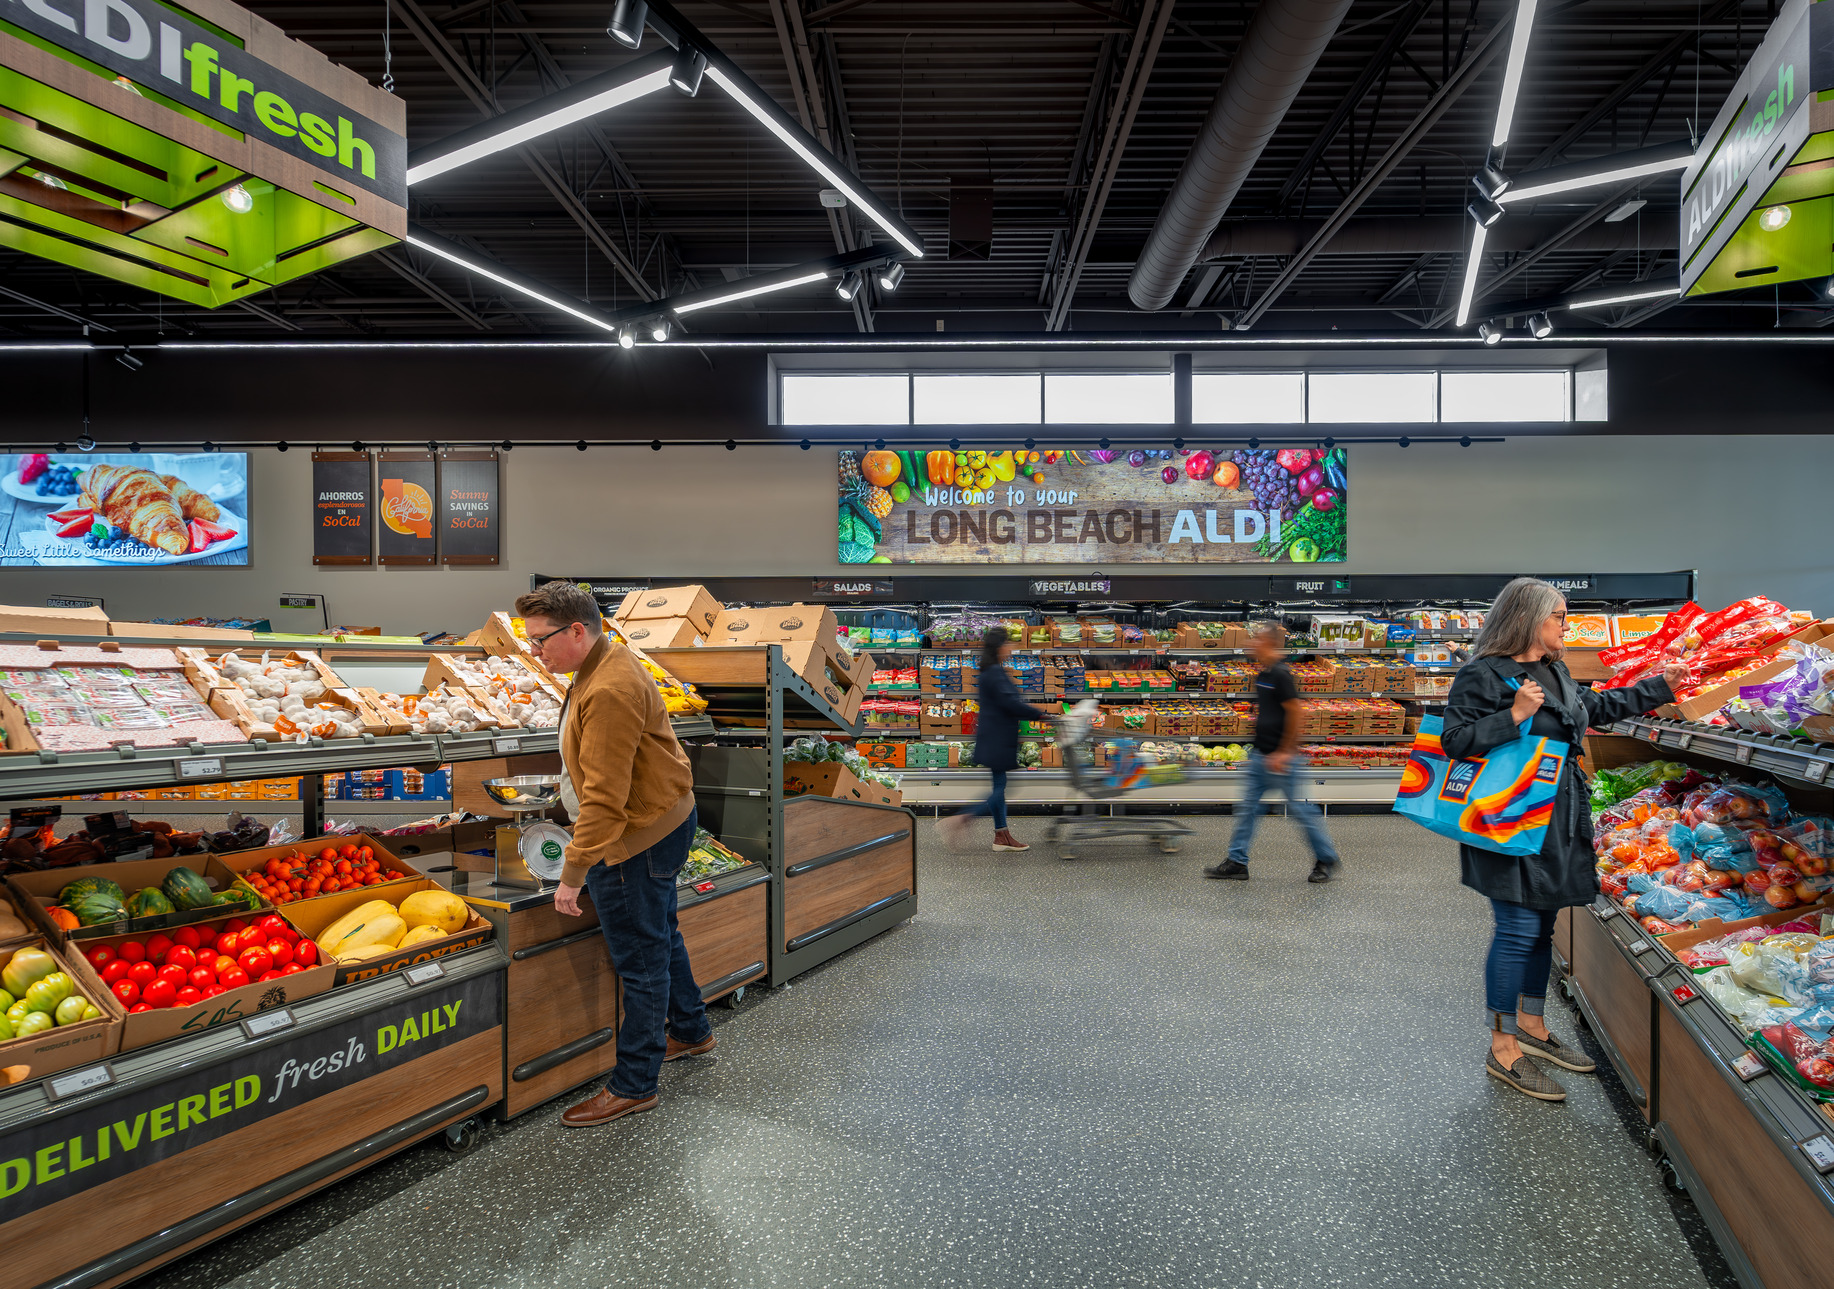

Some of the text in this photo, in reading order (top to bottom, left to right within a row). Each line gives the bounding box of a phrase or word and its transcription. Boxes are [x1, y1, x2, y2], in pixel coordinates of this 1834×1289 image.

[9, 0, 376, 180] LDIfresh
[319, 492, 364, 501] AHORROS
[450, 489, 489, 502] Sunny
[925, 487, 1078, 508] Welcome to your
[318, 501, 365, 510] esplendorosos
[386, 495, 429, 523] California
[450, 502, 489, 511] SAVINGS
[322, 516, 361, 527] SoCal
[450, 517, 488, 529] SoCal
[907, 509, 1281, 545] LONG BEACH ALDI
[0, 542, 166, 563] Sweet Little Somethings
[833, 583, 871, 592] SALADS
[1034, 582, 1105, 591] VEGETABLES
[1296, 582, 1325, 592] FRUIT
[1556, 580, 1589, 589] MEALS
[288, 598, 308, 606] PASTRY
[1446, 781, 1467, 793] ALDI
[34, 1041, 70, 1054] PRODUCE
[72, 1037, 81, 1045] OF
[0, 999, 463, 1199] DELIVERED fresh DAILY
